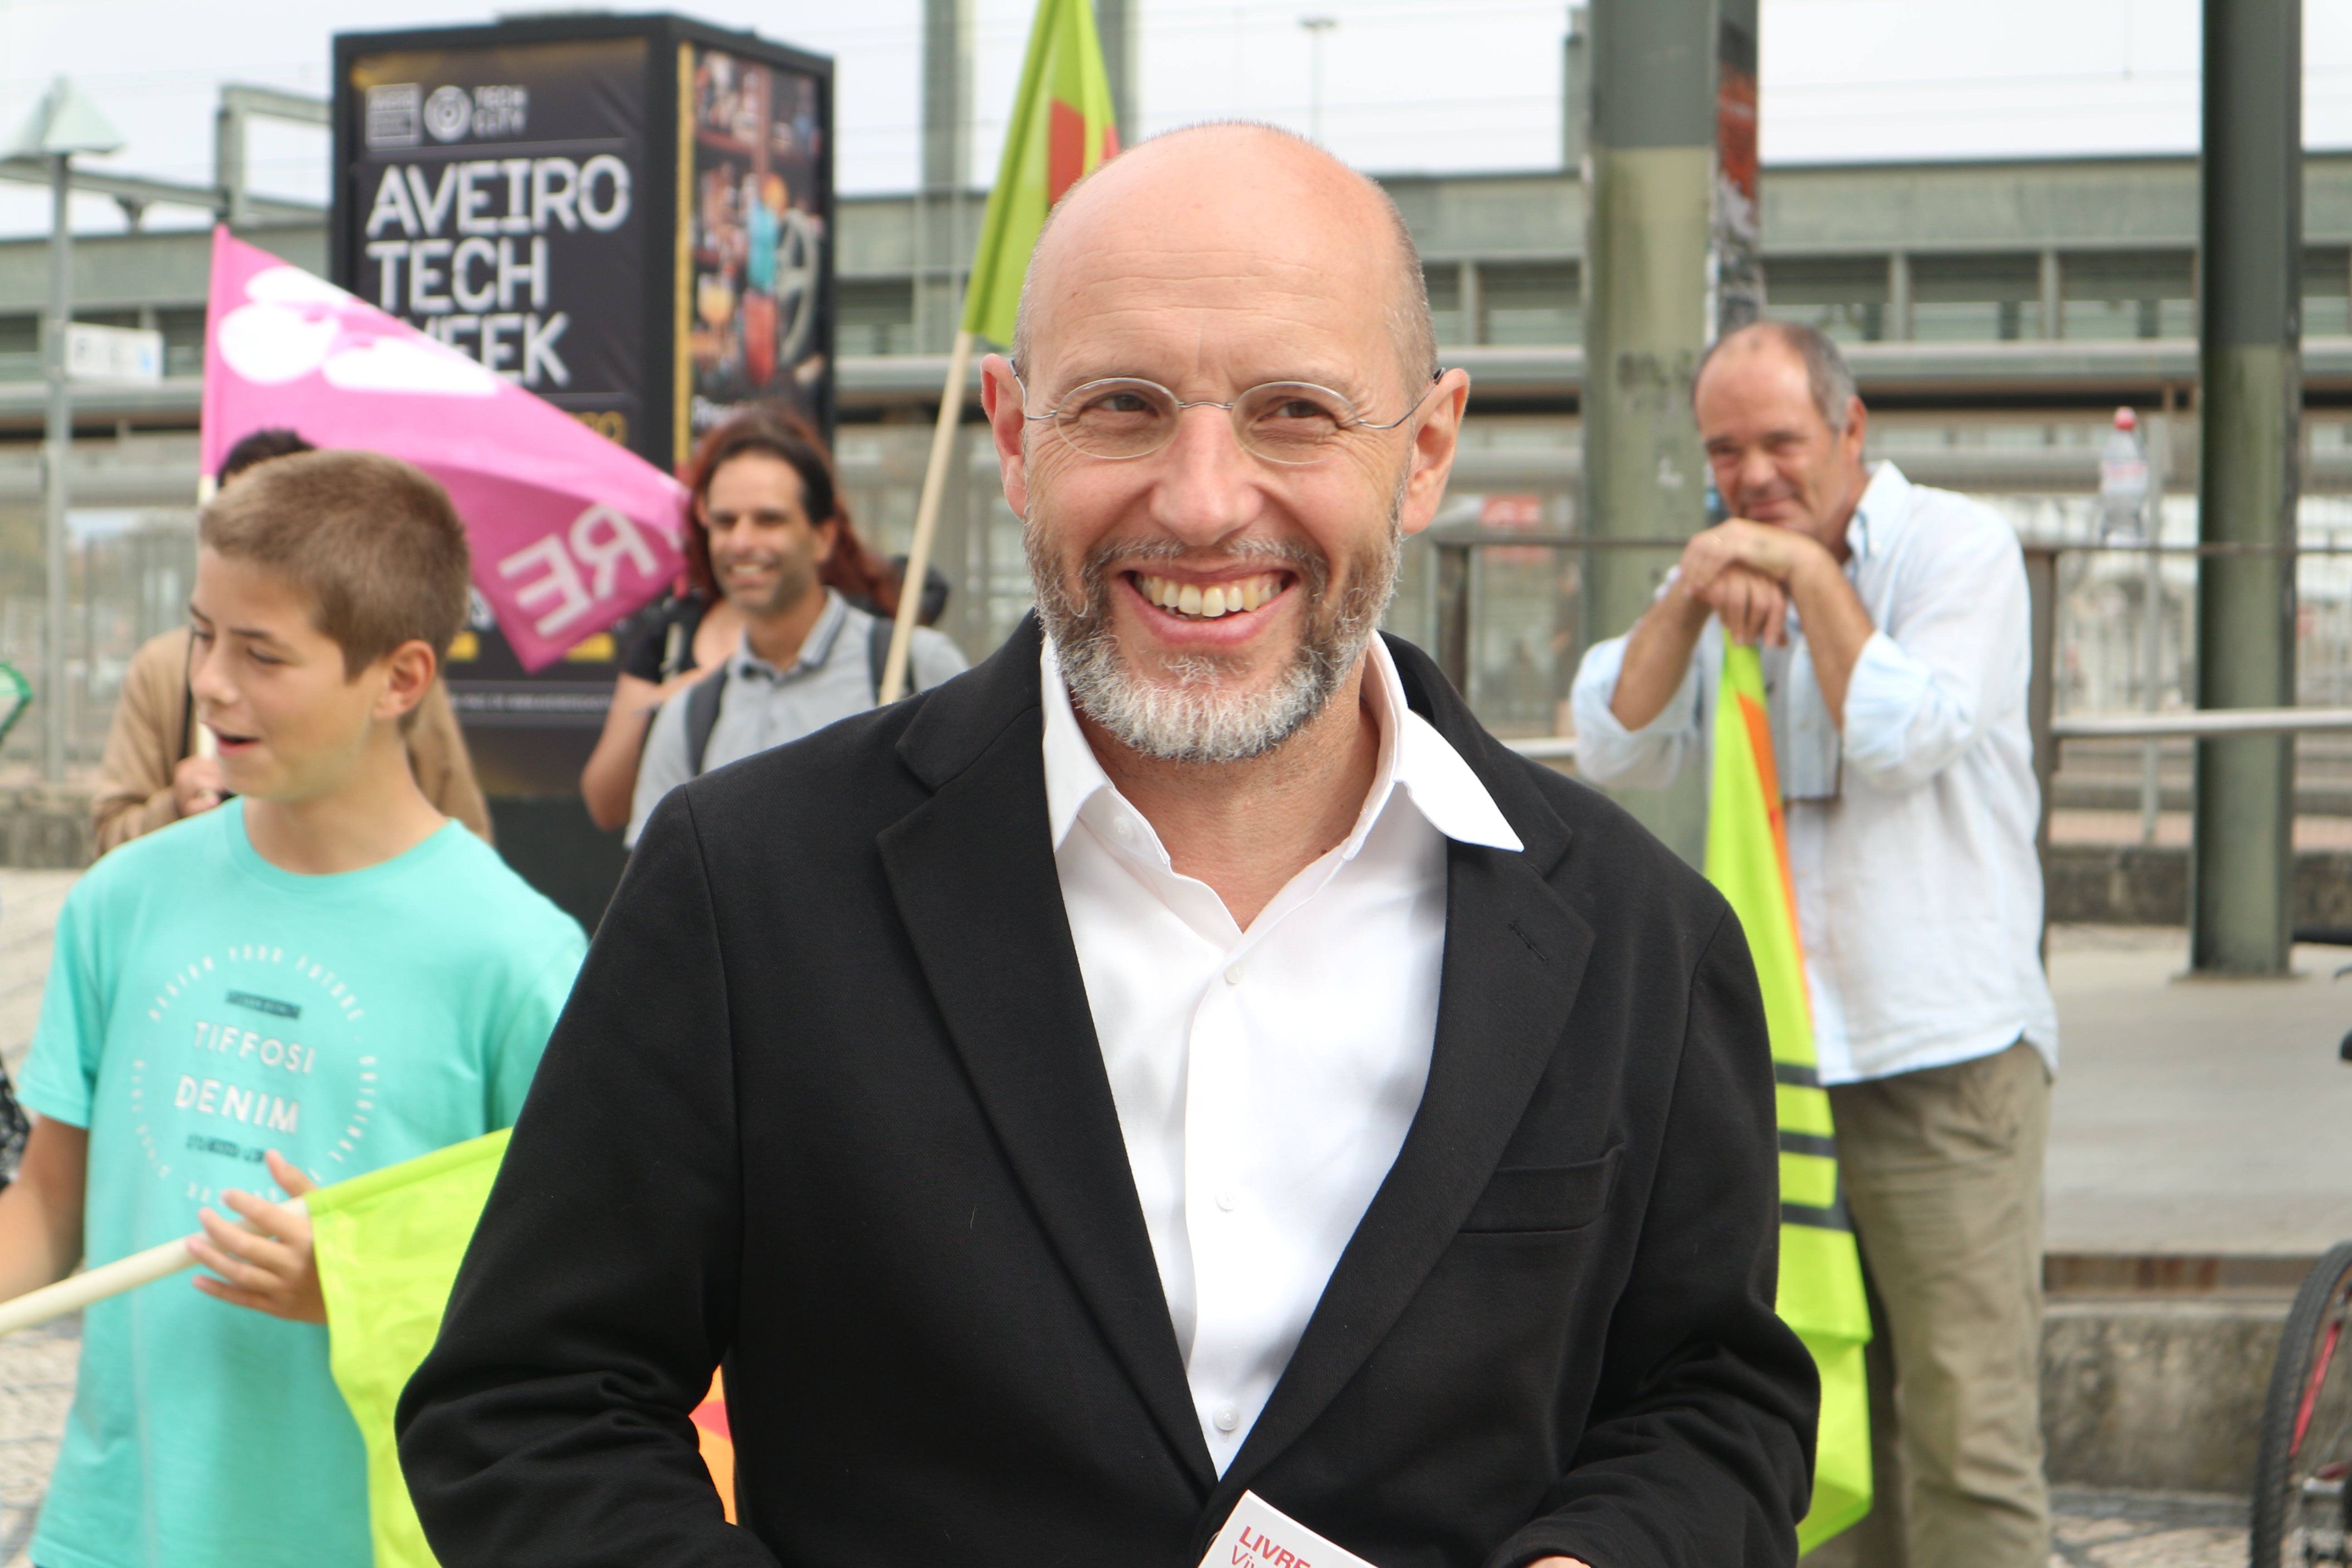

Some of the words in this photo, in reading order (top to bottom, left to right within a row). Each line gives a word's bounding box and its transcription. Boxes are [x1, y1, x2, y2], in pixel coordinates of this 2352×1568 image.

[366, 155, 631, 234] AVEIRO
[366, 238, 547, 311] TECH
[398, 312, 570, 387] EEK
[193, 1021, 316, 1073] TIFFOSI
[173, 1074, 300, 1134] DENIM
